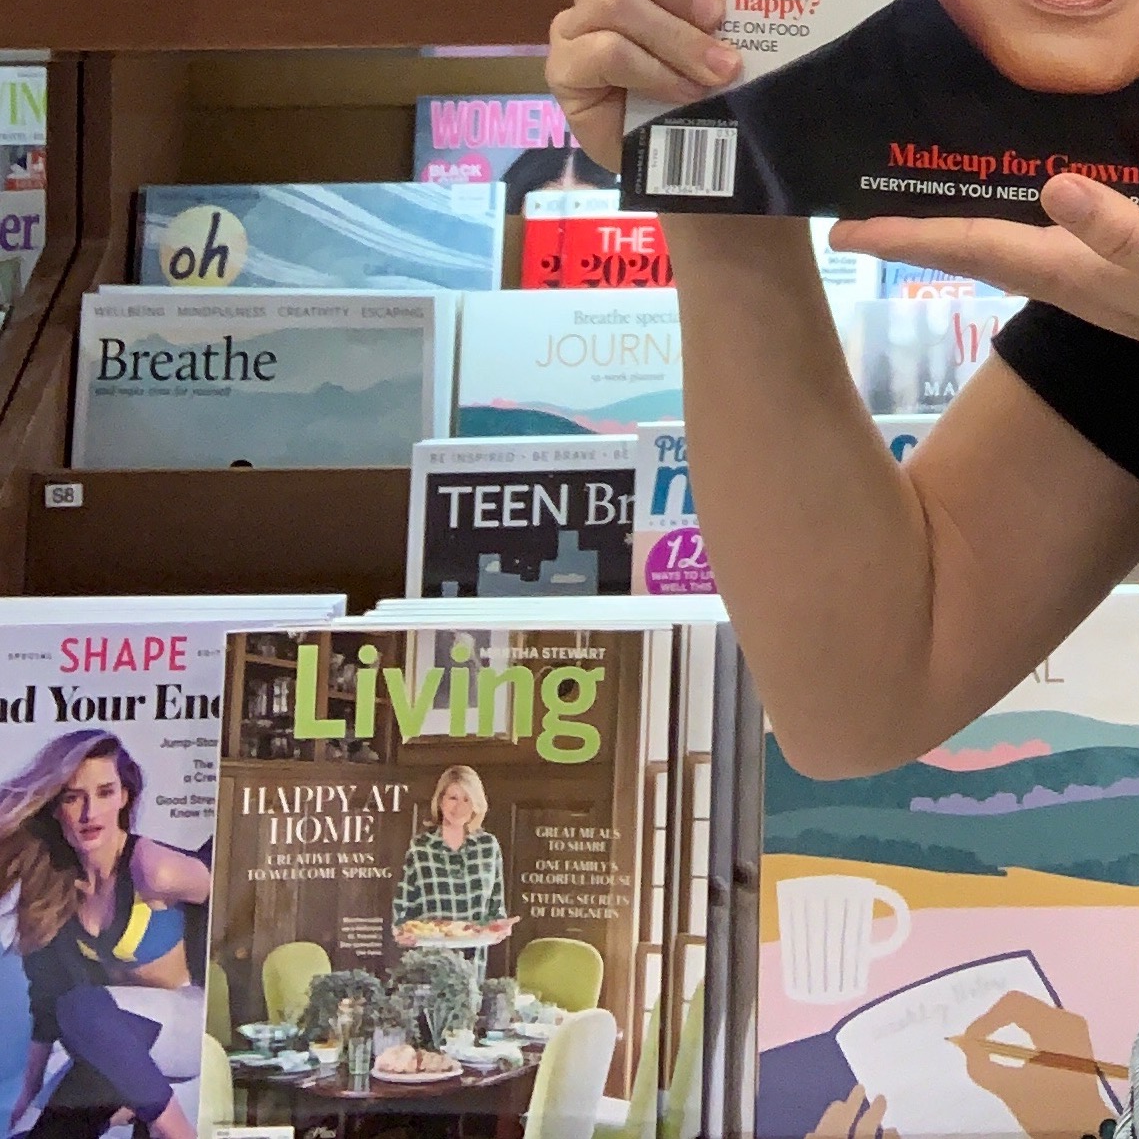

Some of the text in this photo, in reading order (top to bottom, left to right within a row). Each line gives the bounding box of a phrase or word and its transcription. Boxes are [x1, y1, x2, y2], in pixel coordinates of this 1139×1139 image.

[743, 22, 811, 37] ON FOOD
[888, 142, 997, 180] Makeup
[1002, 150, 1041, 178] for
[860, 176, 1040, 202] EVERYTHING YOU NEED
[169, 211, 230, 280] oh
[598, 226, 656, 254] THE
[574, 310, 630, 326] Breathe
[97, 335, 278, 382] Breathe
[536, 332, 682, 369] JOURN
[52, 487, 74, 504] S8
[438, 483, 569, 528] TEEN
[59, 636, 188, 673] SHAPE
[542, 647, 606, 660] STEWART
[48, 685, 146, 723] Your
[293, 644, 605, 764] Living
[242, 784, 409, 814] HAPPY AT
[270, 815, 375, 845] HOME
[535, 826, 621, 839] GREAT MEALS
[267, 852, 375, 866] CREATIVE WAYS
[548, 841, 607, 852] TO SHARE
[248, 867, 393, 881] TO WELCOME SPRING
[521, 872, 585, 885] COLORFUL
[535, 860, 560, 870] ONE
